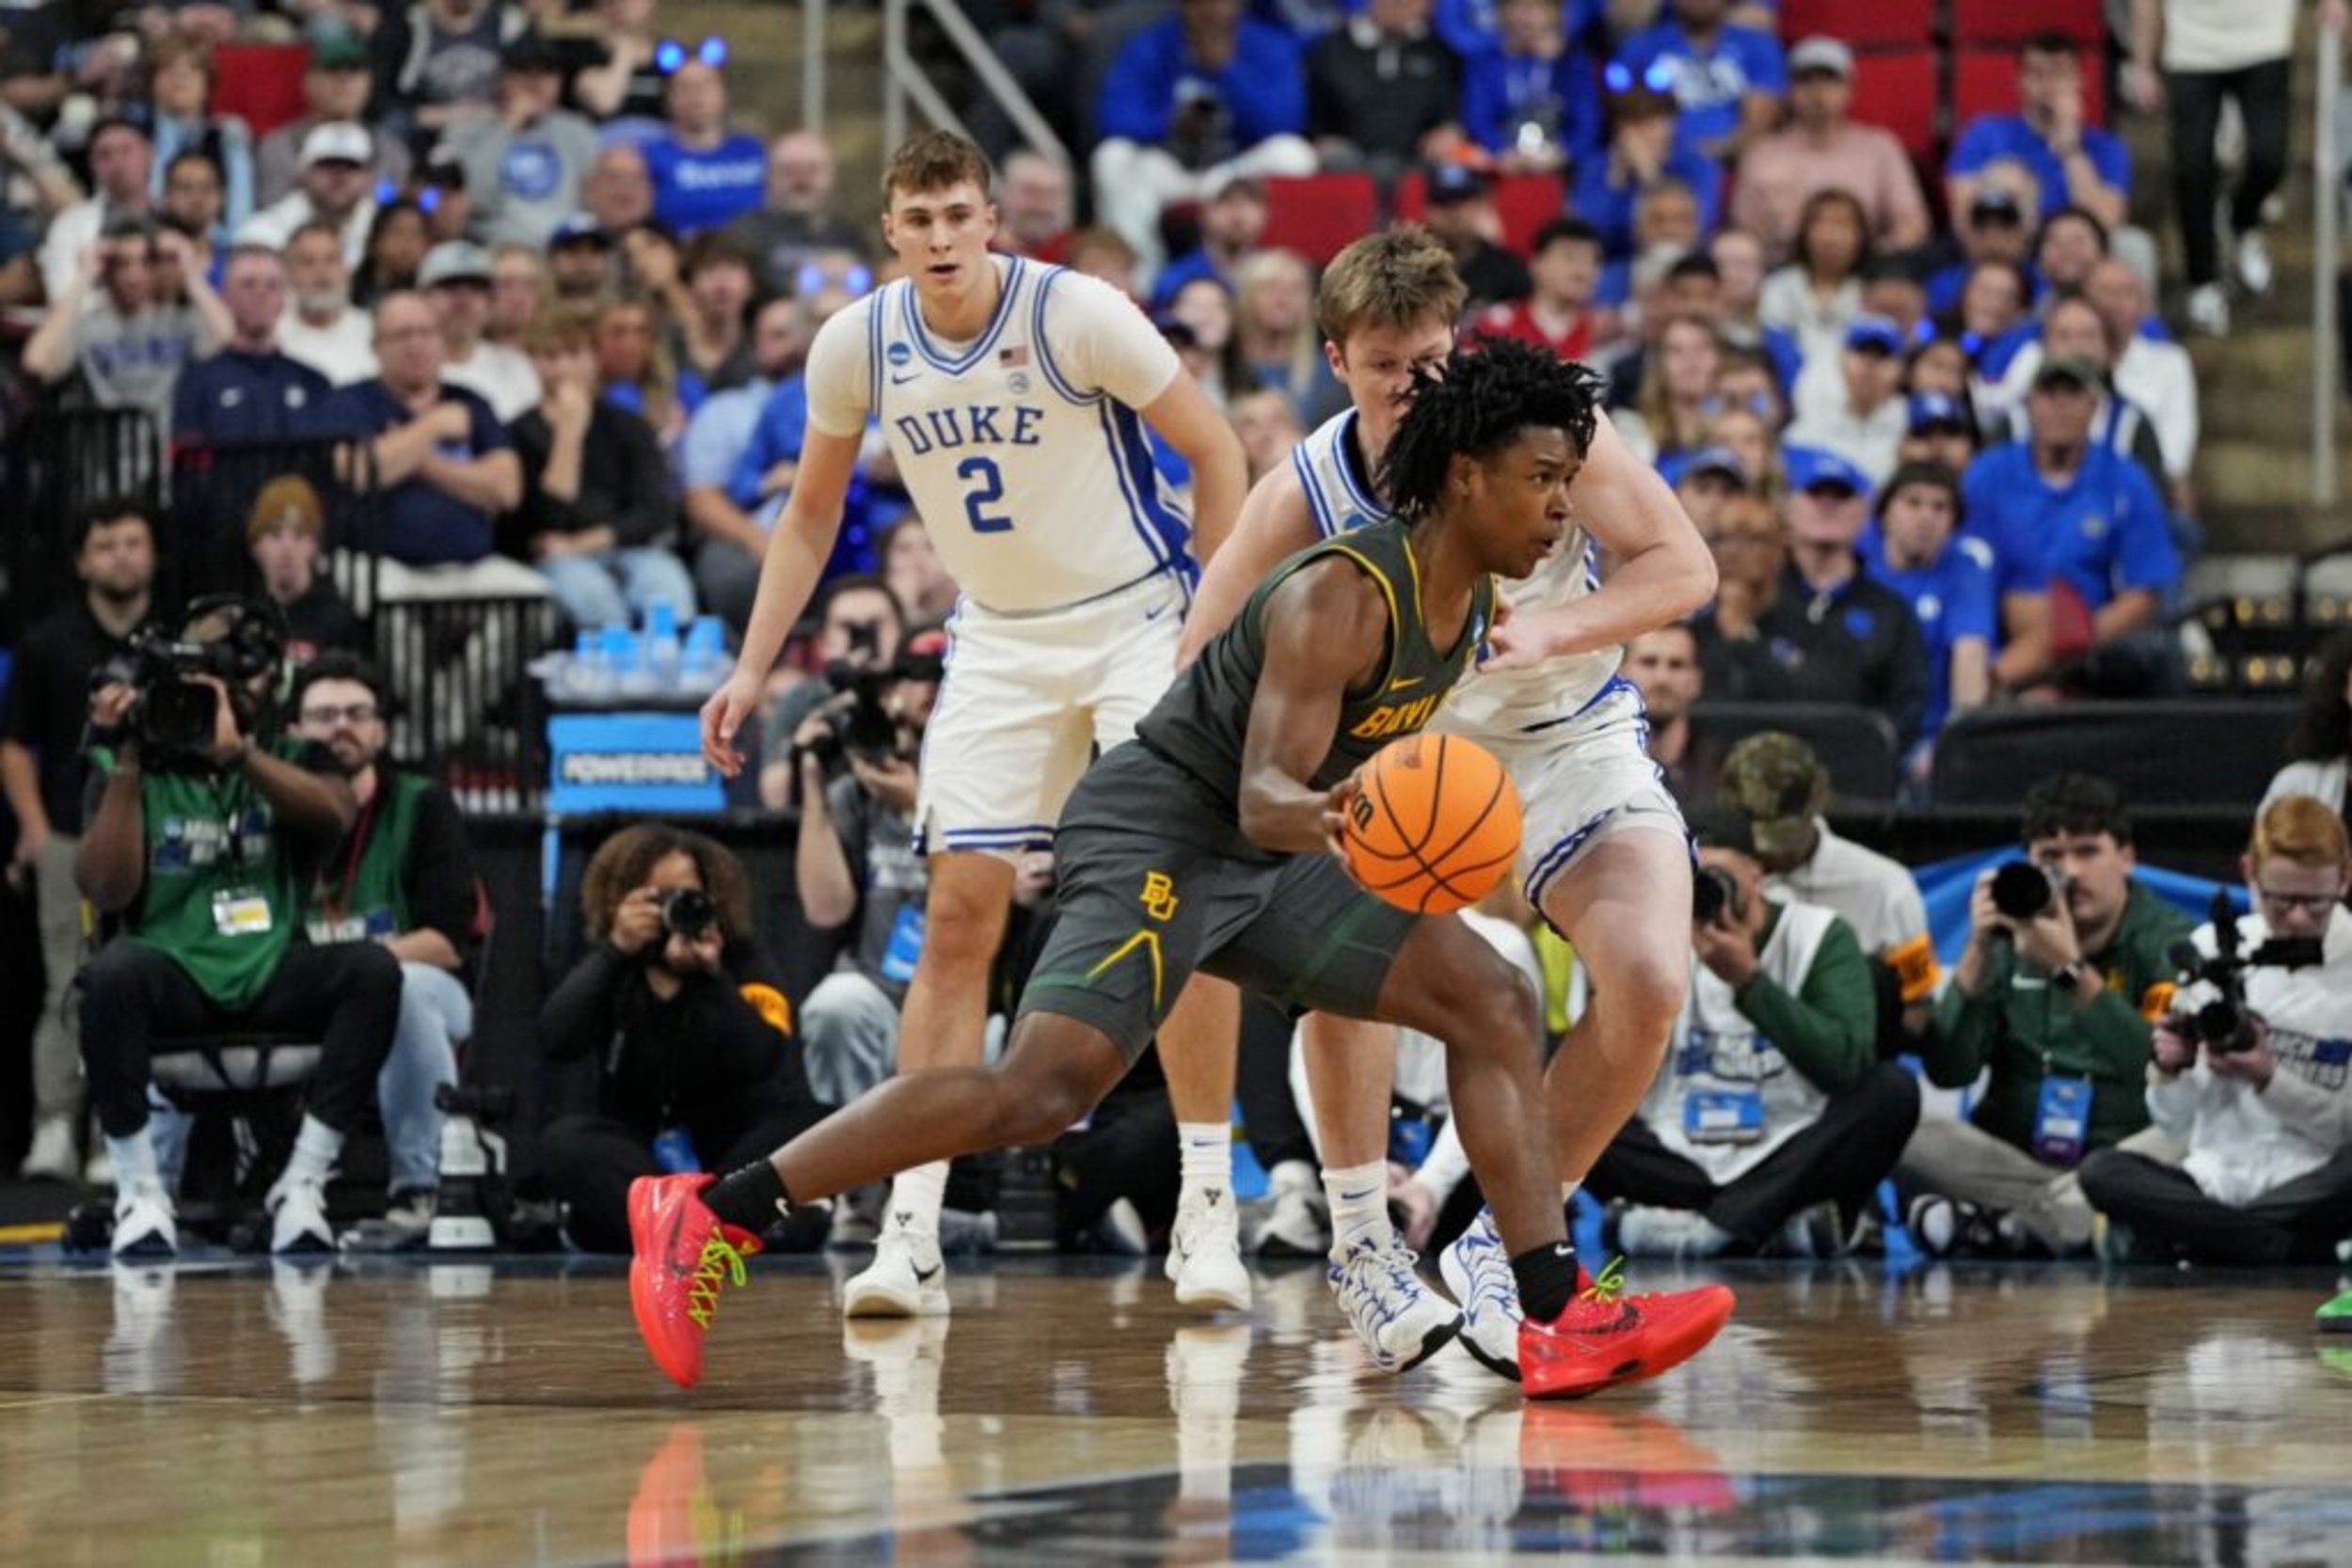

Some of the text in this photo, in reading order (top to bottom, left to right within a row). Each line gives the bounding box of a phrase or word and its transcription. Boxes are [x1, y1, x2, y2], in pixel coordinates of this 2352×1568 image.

[895, 405, 1044, 455] DUKE
[957, 455, 1014, 533] 2
[1138, 871, 1179, 921] BU
